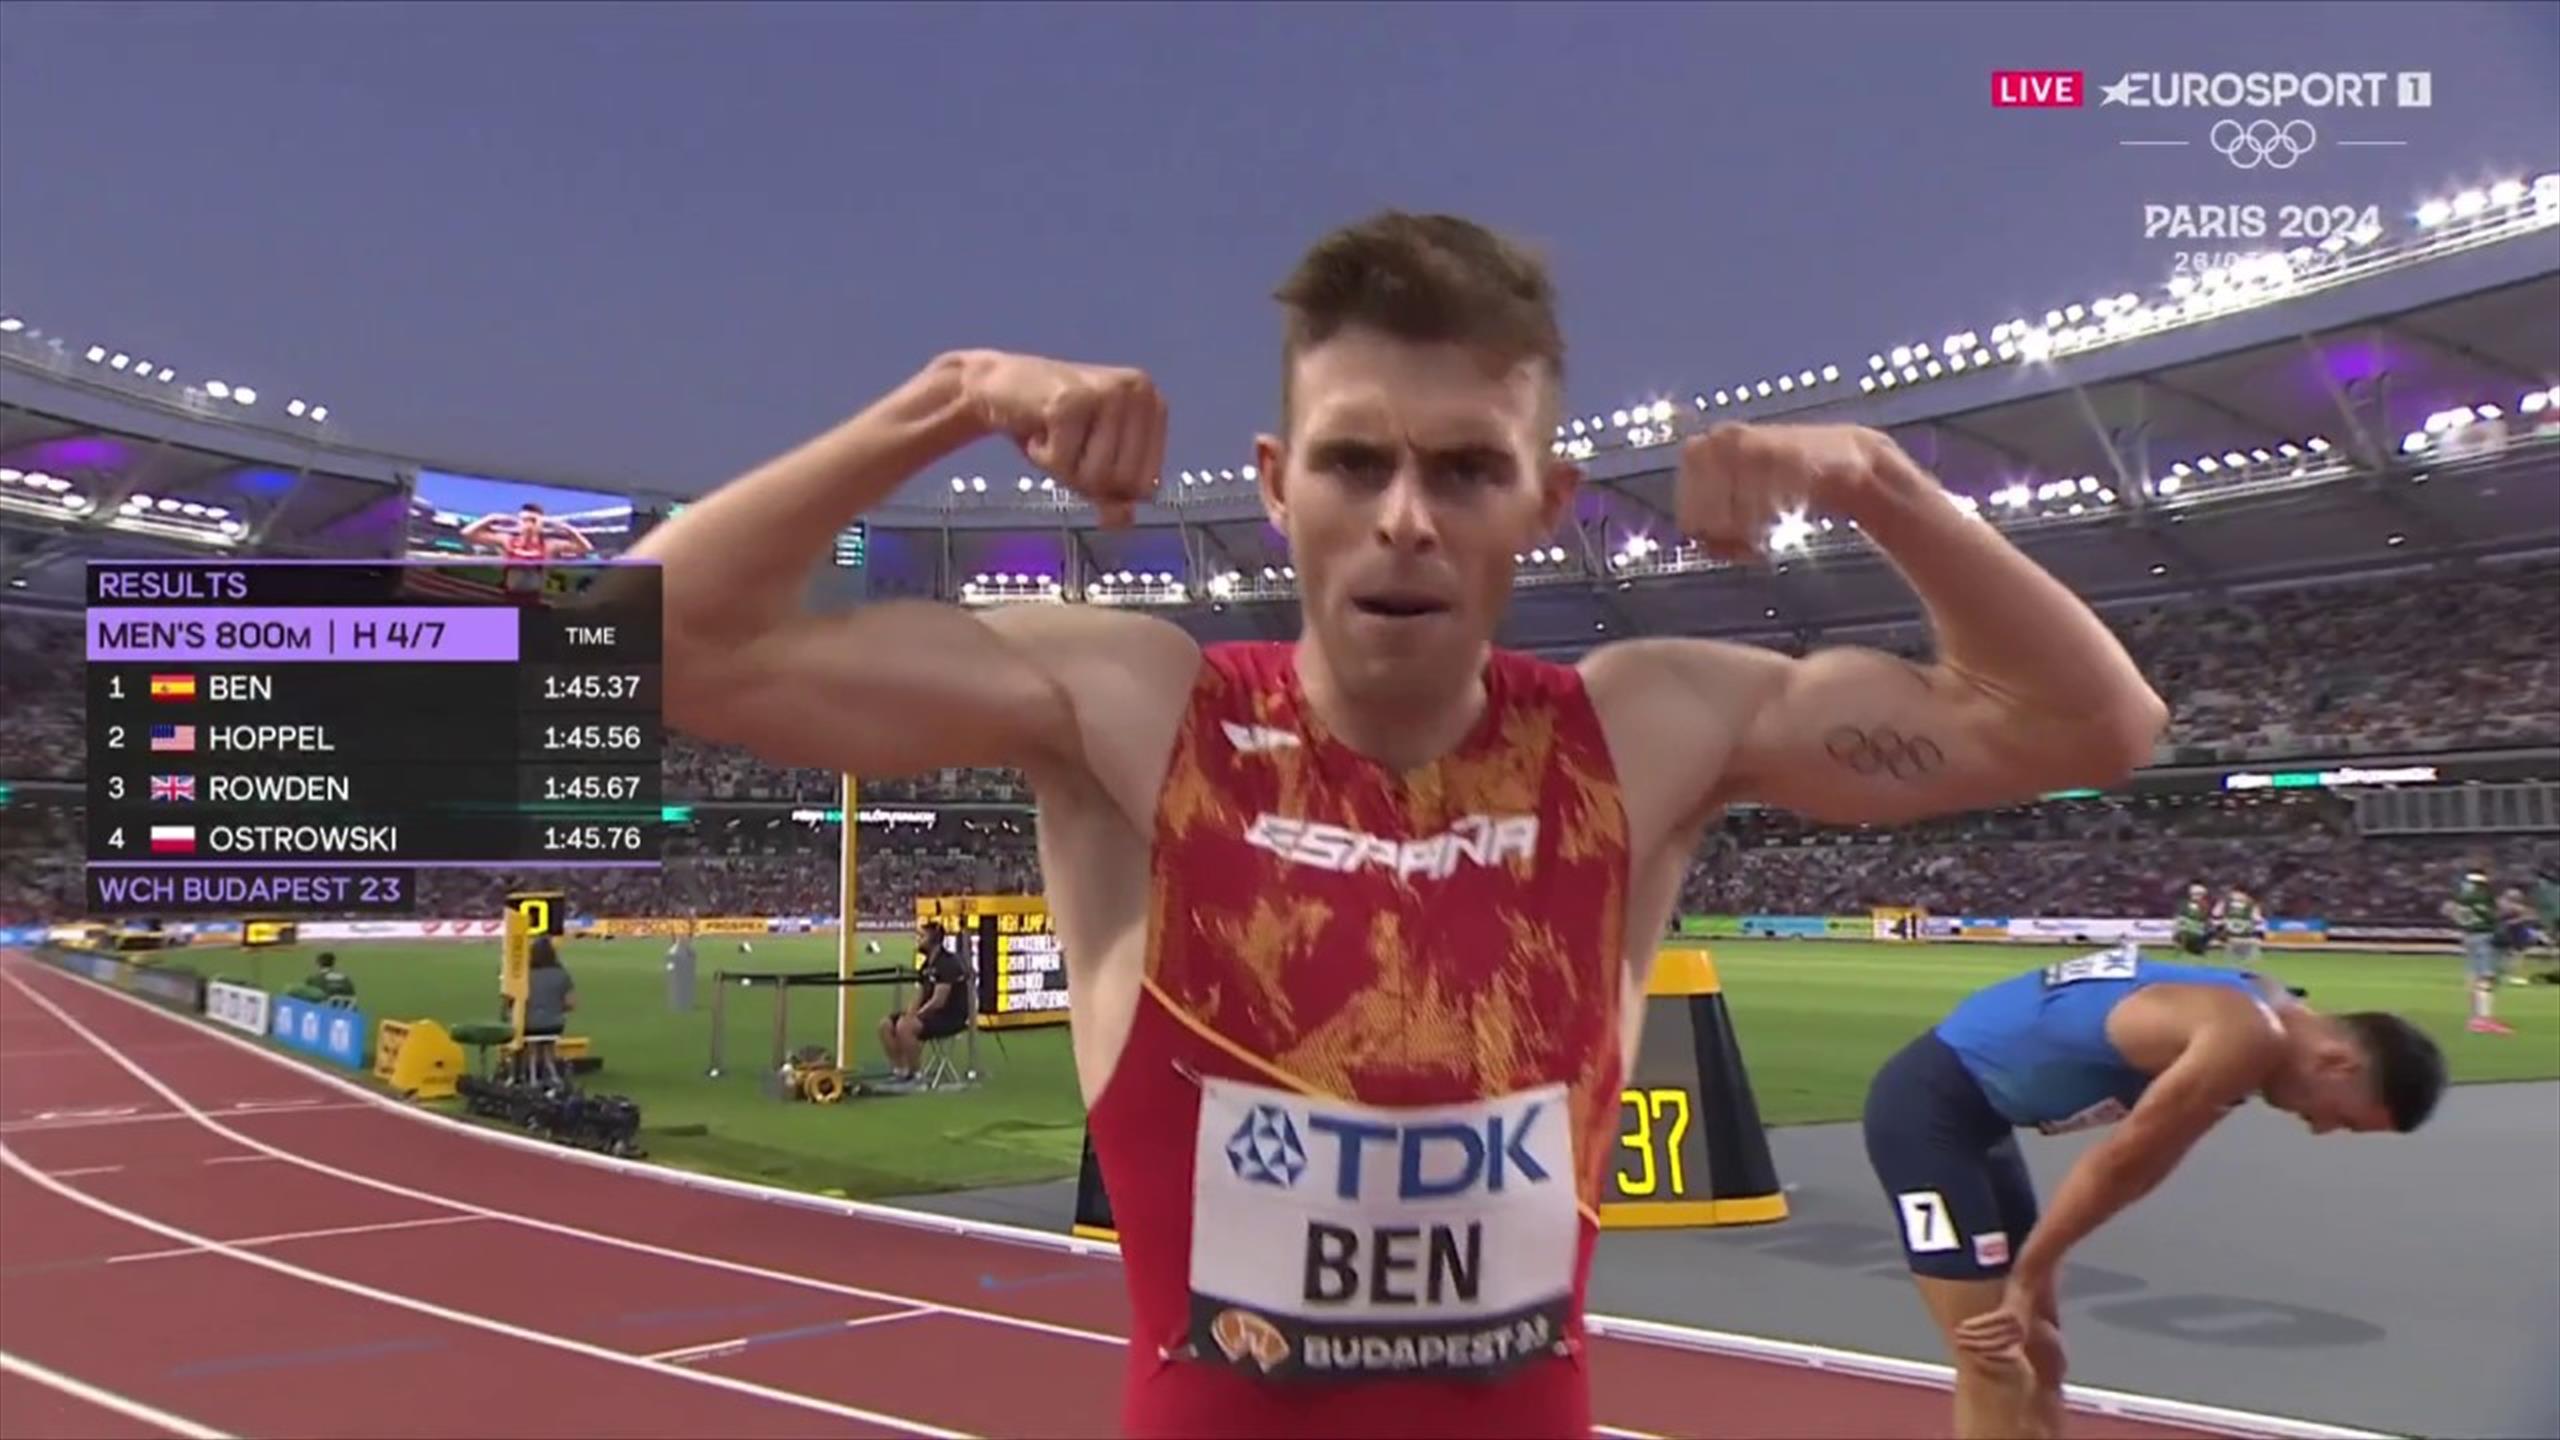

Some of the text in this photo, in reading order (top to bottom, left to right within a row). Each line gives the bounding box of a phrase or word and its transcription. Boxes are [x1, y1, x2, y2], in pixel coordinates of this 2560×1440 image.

[1244, 813, 1539, 879] ESPAÑA
[1307, 1103, 1550, 1201] TDK
[1616, 1088, 1689, 1195] 37
[1303, 1221, 1482, 1306] BEN
[1914, 1202, 1934, 1243] 7
